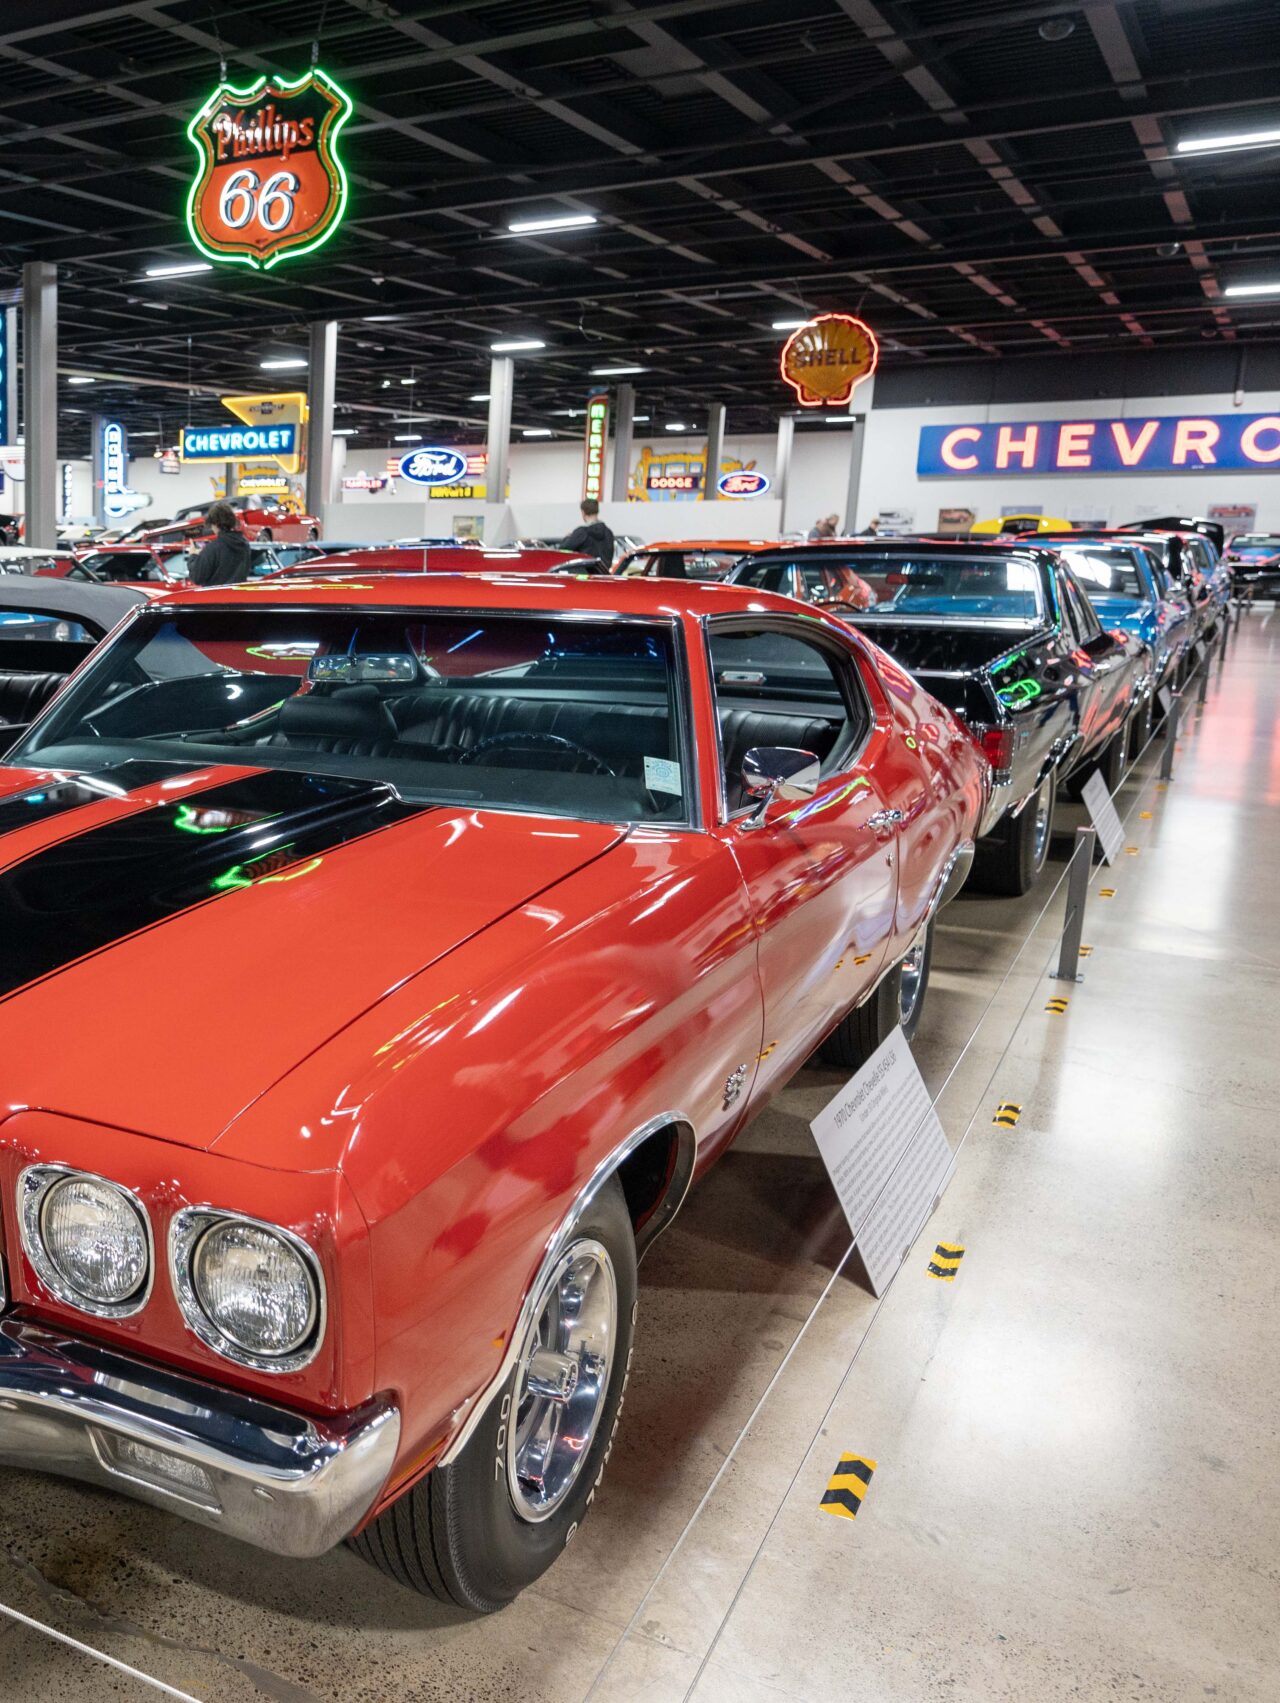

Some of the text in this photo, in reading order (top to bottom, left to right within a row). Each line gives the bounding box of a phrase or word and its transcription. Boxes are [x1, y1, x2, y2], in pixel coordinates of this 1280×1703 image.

[212, 104, 315, 162] Phillips
[220, 168, 300, 232] 66
[795, 347, 861, 368] SHELL
[184, 429, 291, 452] CHEVROLET
[939, 416, 1280, 471] CHEVRO
[408, 453, 458, 477] Ford
[651, 478, 693, 489] DODGE
[724, 476, 761, 493] Ford
